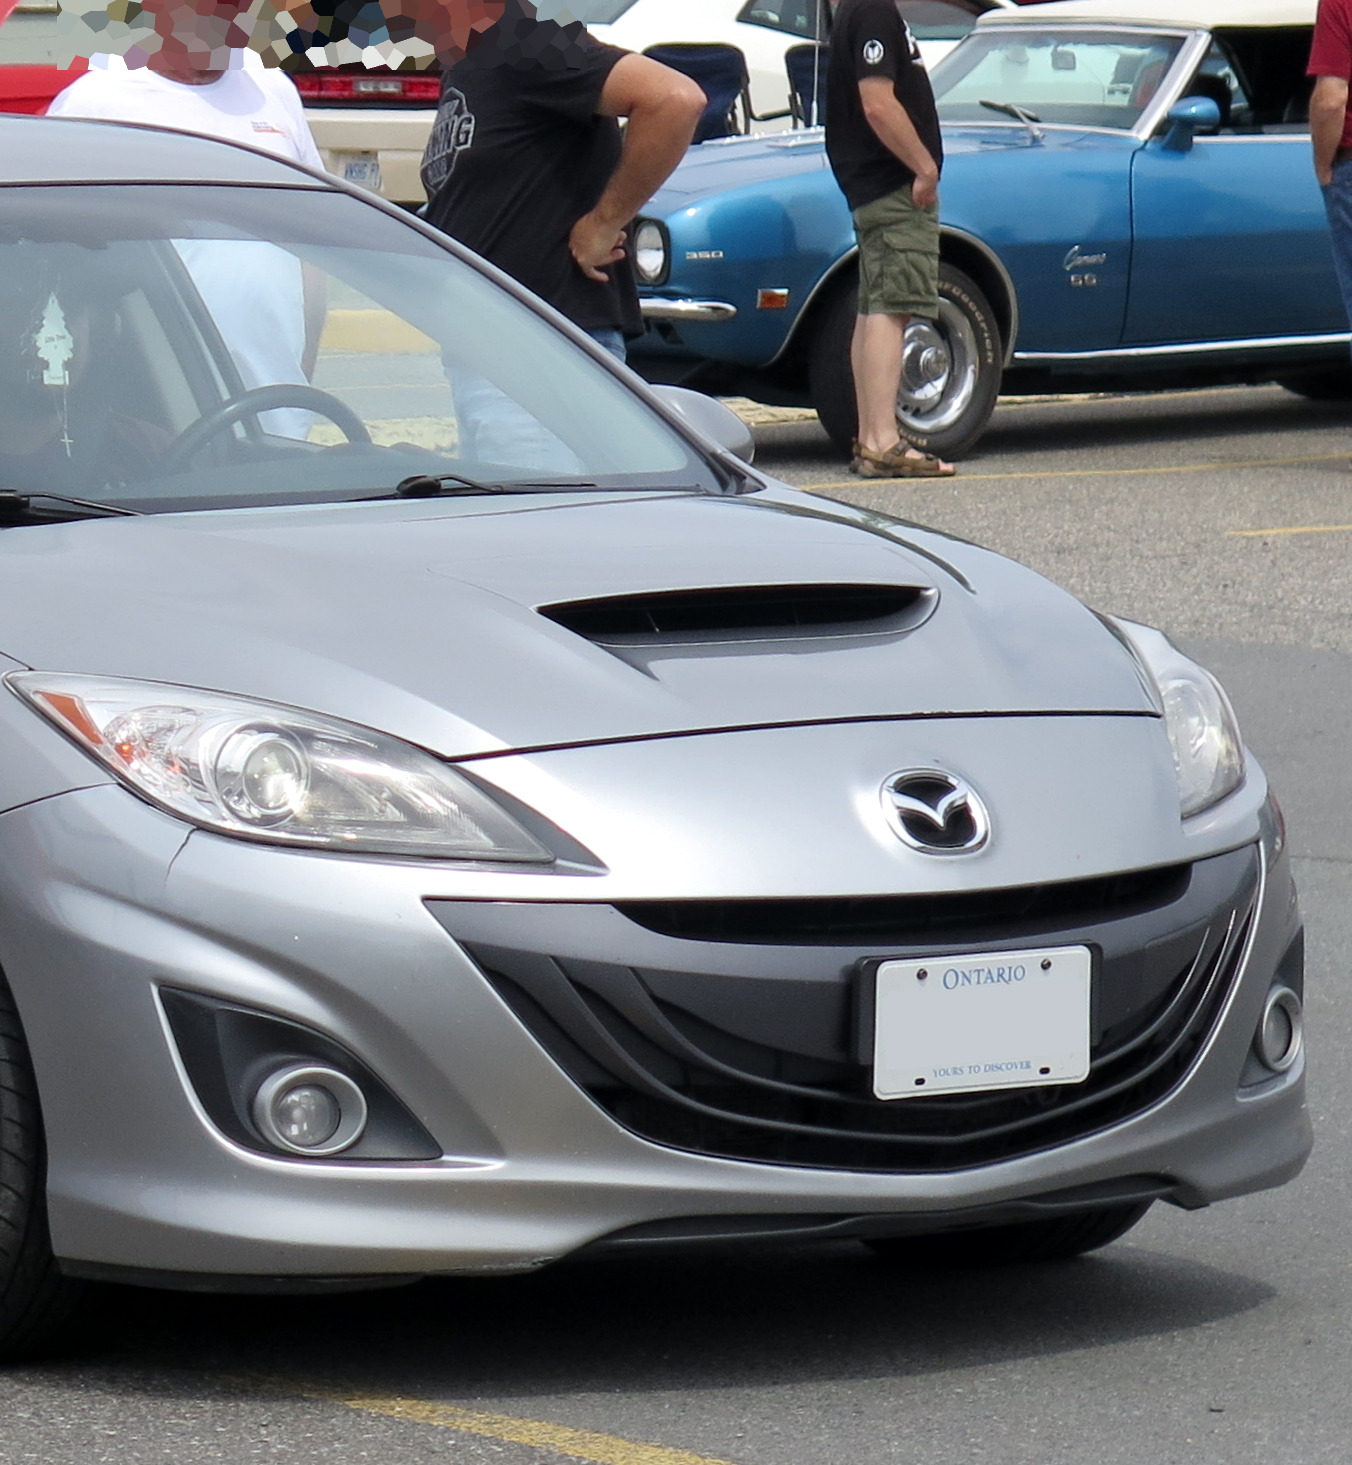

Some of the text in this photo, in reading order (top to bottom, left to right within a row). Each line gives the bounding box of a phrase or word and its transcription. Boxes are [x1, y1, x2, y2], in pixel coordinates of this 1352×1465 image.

[932, 1060, 1032, 1078] YOURS TO DISCOVER
